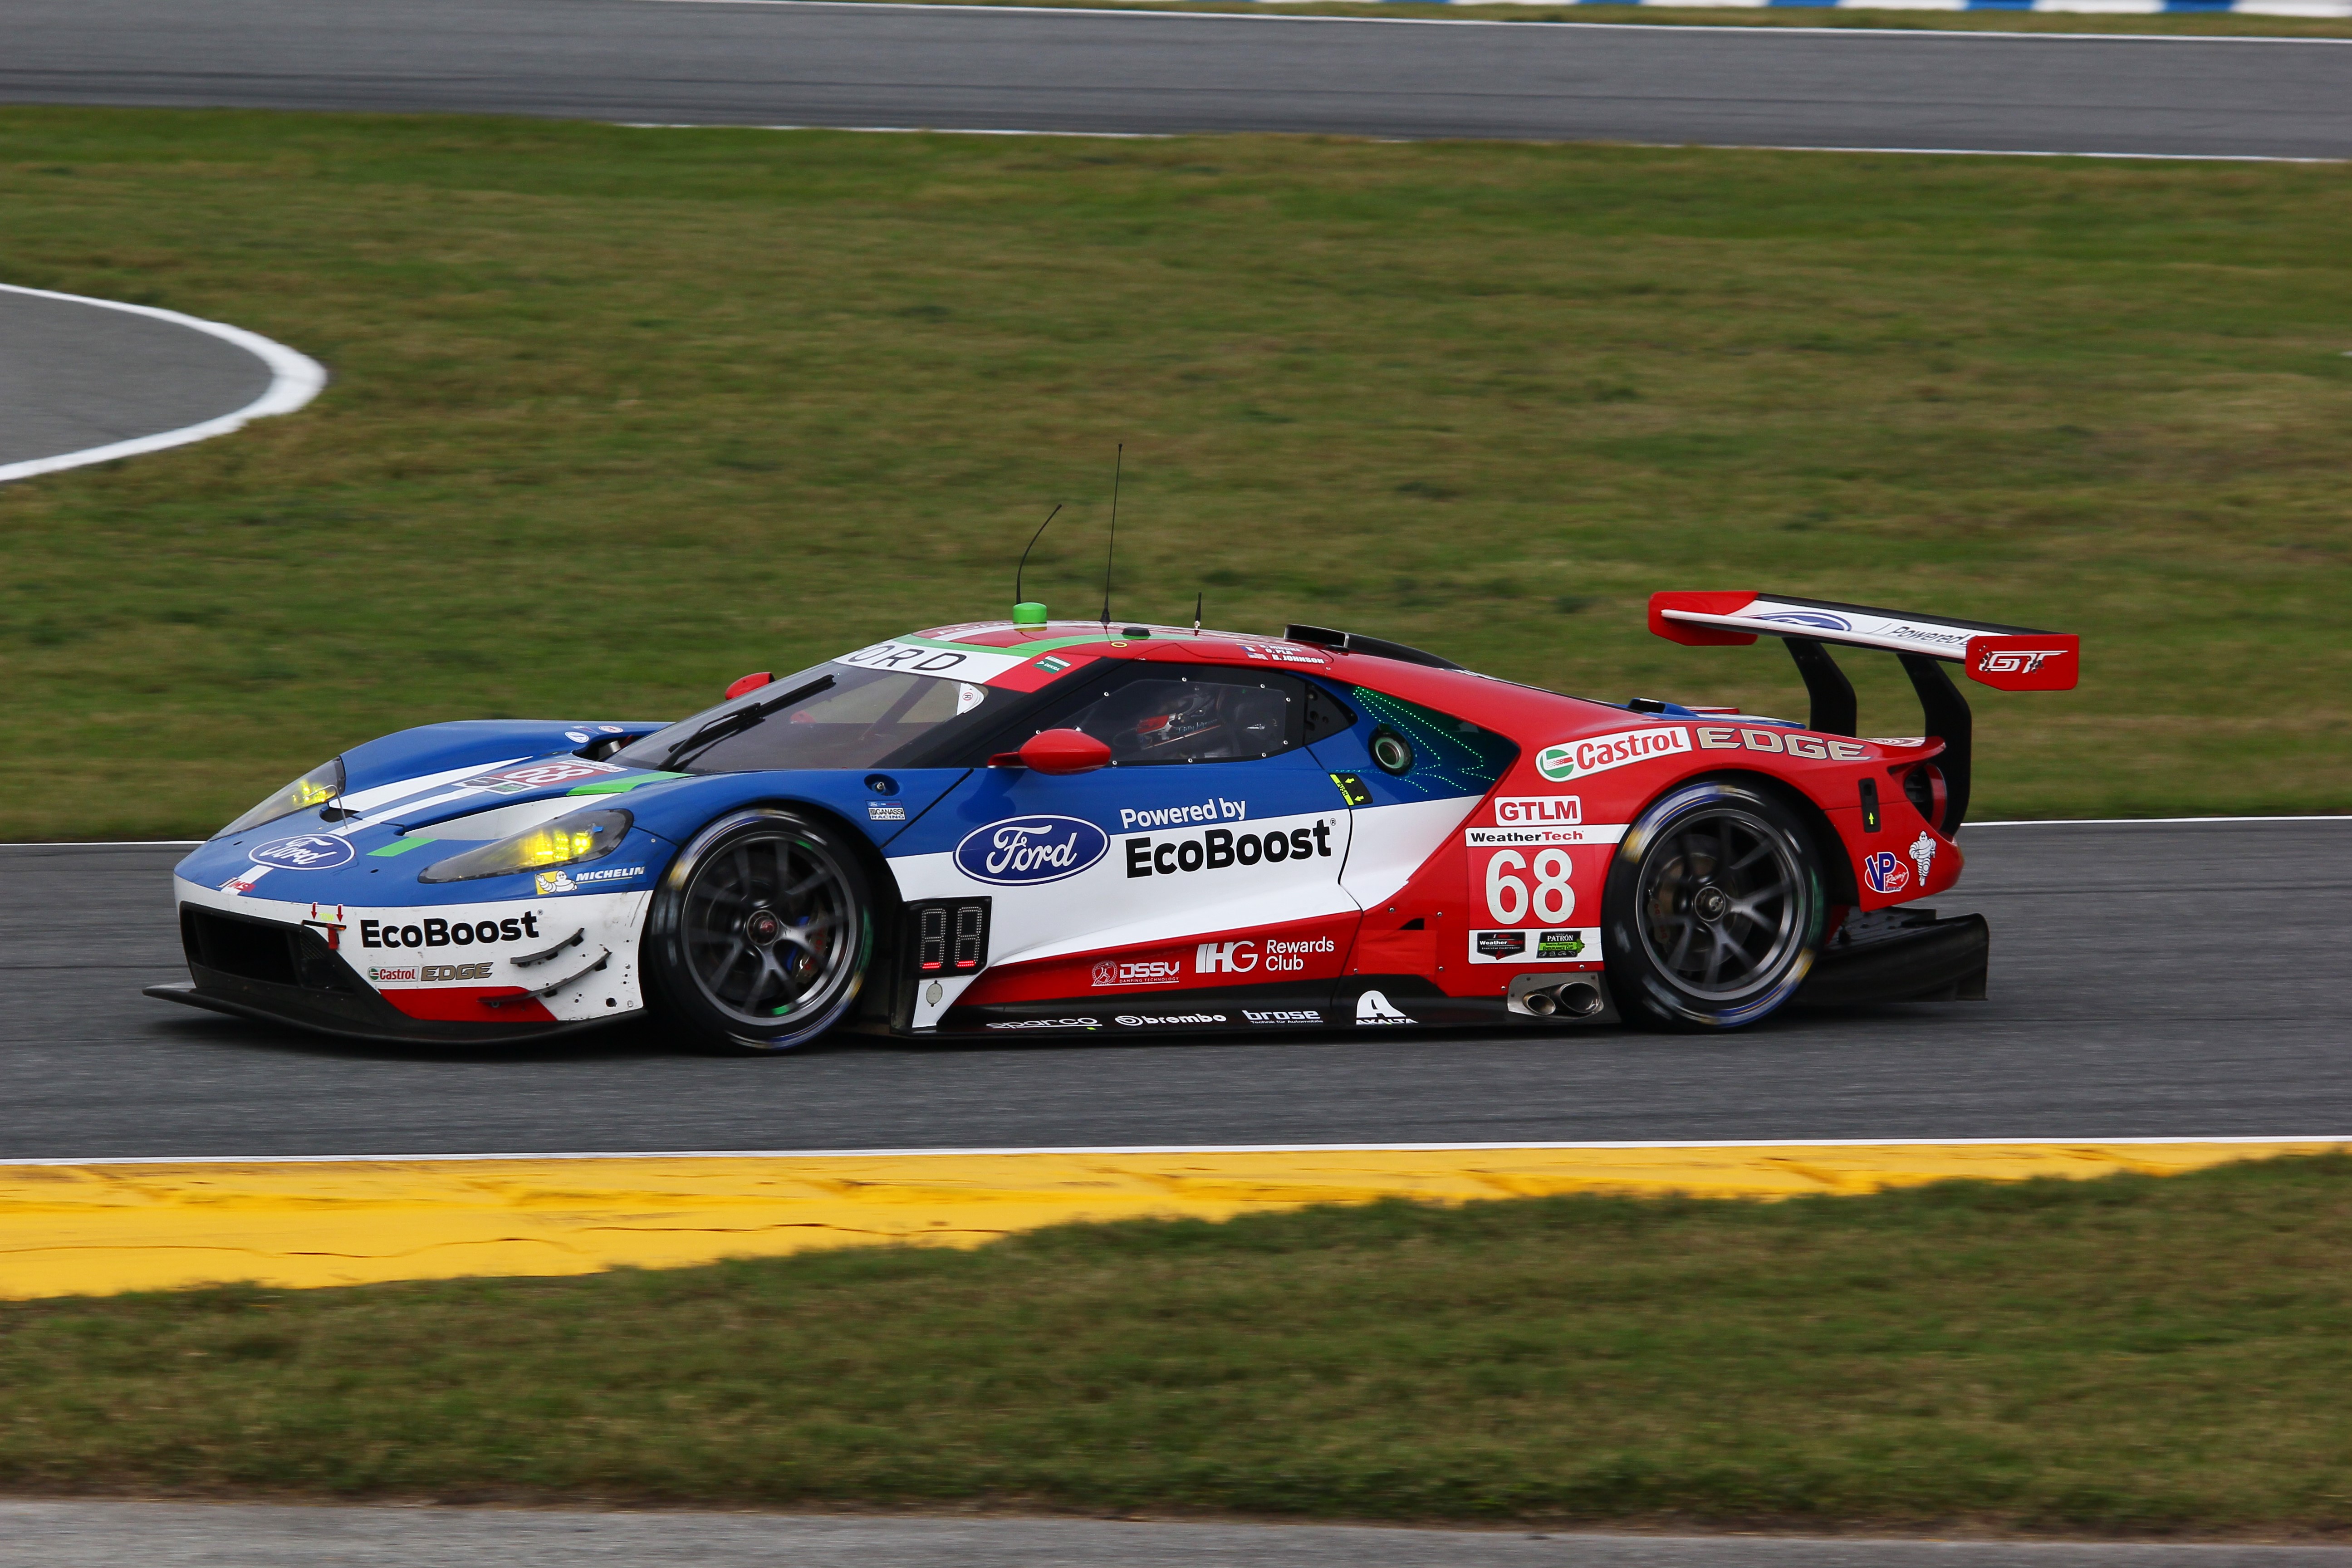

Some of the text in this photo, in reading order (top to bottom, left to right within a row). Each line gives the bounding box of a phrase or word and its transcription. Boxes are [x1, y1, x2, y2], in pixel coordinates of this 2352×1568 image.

[1886, 627, 1970, 643] Powered
[848, 642, 967, 671] ORD
[1979, 651, 2068, 673] GT
[1577, 727, 1872, 769] Castrol EDGE
[504, 765, 594, 783] 68
[1337, 782, 1348, 796] PUSH
[1120, 797, 1246, 829] Powered by
[1499, 800, 1578, 821] GTLM
[1470, 831, 1583, 842] WeatherTech
[259, 837, 337, 865] Ford
[986, 824, 1078, 874] Ford
[1125, 818, 1332, 879] EcoBoost
[576, 867, 645, 882] MICHELIN
[1865, 852, 1897, 892] VP
[1485, 848, 1575, 925] 68
[319, 912, 334, 921] TOW
[360, 911, 539, 948] EcoBoost
[1266, 936, 1335, 954] Rewards
[1196, 941, 1258, 973] IHG
[1266, 954, 1303, 971] Club
[379, 962, 494, 982] Castrol EDGE
[1119, 961, 1179, 978] DSSV
[986, 1017, 1098, 1029] sparco
[1141, 1013, 1227, 1024] brembo
[1242, 1010, 1321, 1020] brose
